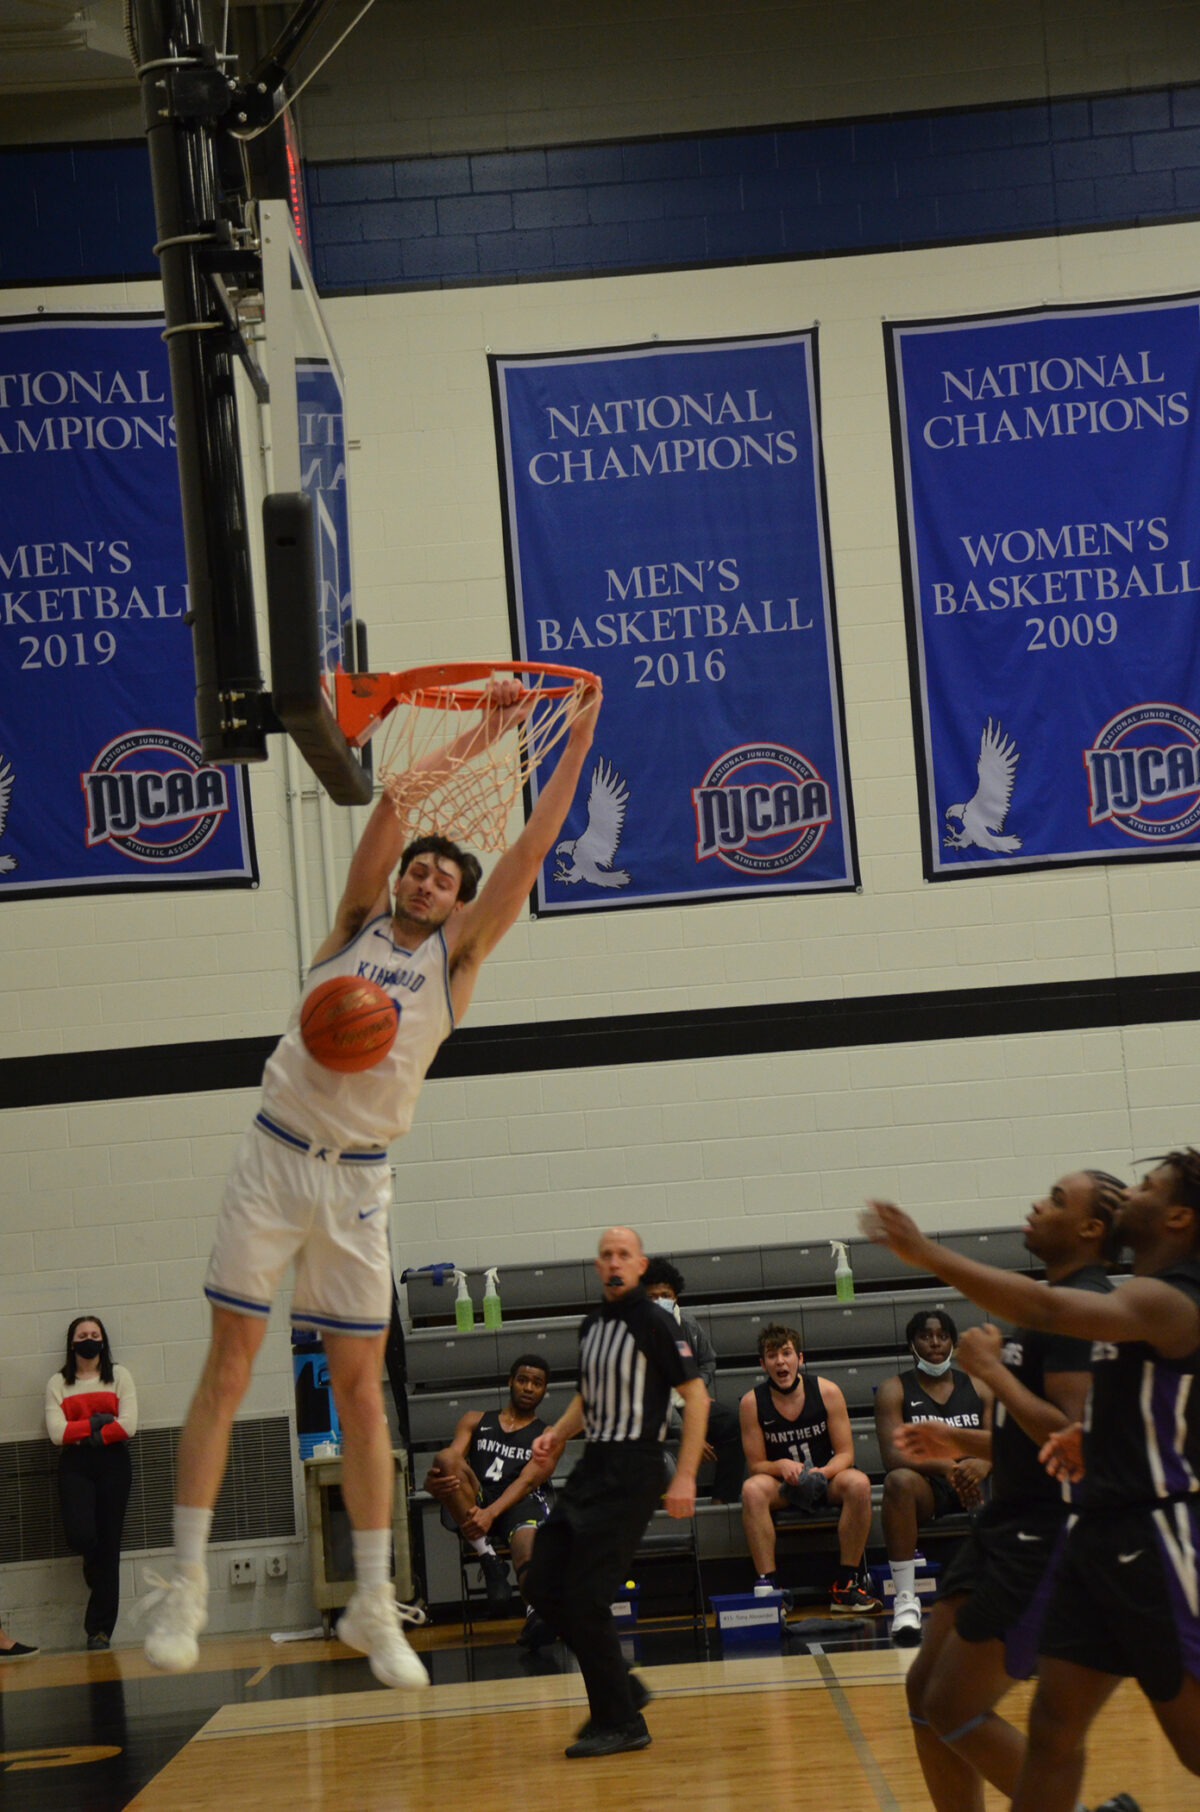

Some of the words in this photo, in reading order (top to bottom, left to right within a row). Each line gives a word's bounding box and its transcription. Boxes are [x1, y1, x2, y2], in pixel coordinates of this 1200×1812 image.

[941, 351, 1165, 403] NATIONAL
[546, 389, 773, 440] NATIONAL
[923, 392, 1190, 450] CHAMPIONS
[528, 430, 798, 486] CHAMPIONS
[0, 540, 132, 580] MEN'S
[960, 517, 1169, 567] WOMEN'S
[605, 558, 740, 602] MEN'S
[932, 560, 1200, 616] BASKETBALL
[537, 598, 814, 652] BASKETBALL
[1025, 612, 1118, 652] 2009
[19, 630, 117, 670] 2019
[634, 648, 726, 690] 2016
[1103, 716, 1138, 746] NATIONAL
[1139, 711, 1171, 720] JUNIOR
[101, 741, 136, 769] NATIONAL
[138, 737, 170, 746] JUNIOR
[172, 742, 203, 765] COLLEG
[711, 755, 744, 784] NATIONAL
[747, 751, 777, 760] JUNIOR
[778, 754, 810, 778] COLLEGE
[1089, 744, 1200, 819] NJCA
[86, 769, 226, 840] NJCAA
[697, 780, 829, 853] NJCAA
[126, 841, 165, 857] ATHLETIC
[168, 818, 212, 856] ASSOCIATION
[1128, 819, 1167, 833] ATHLETIC
[734, 854, 771, 868] ATHLETIC
[774, 828, 816, 867] ASSOCIATION
[477, 1438, 532, 1461] PANTHERS
[764, 1420, 827, 1444] PANTHERS
[485, 1456, 504, 1482] 4
